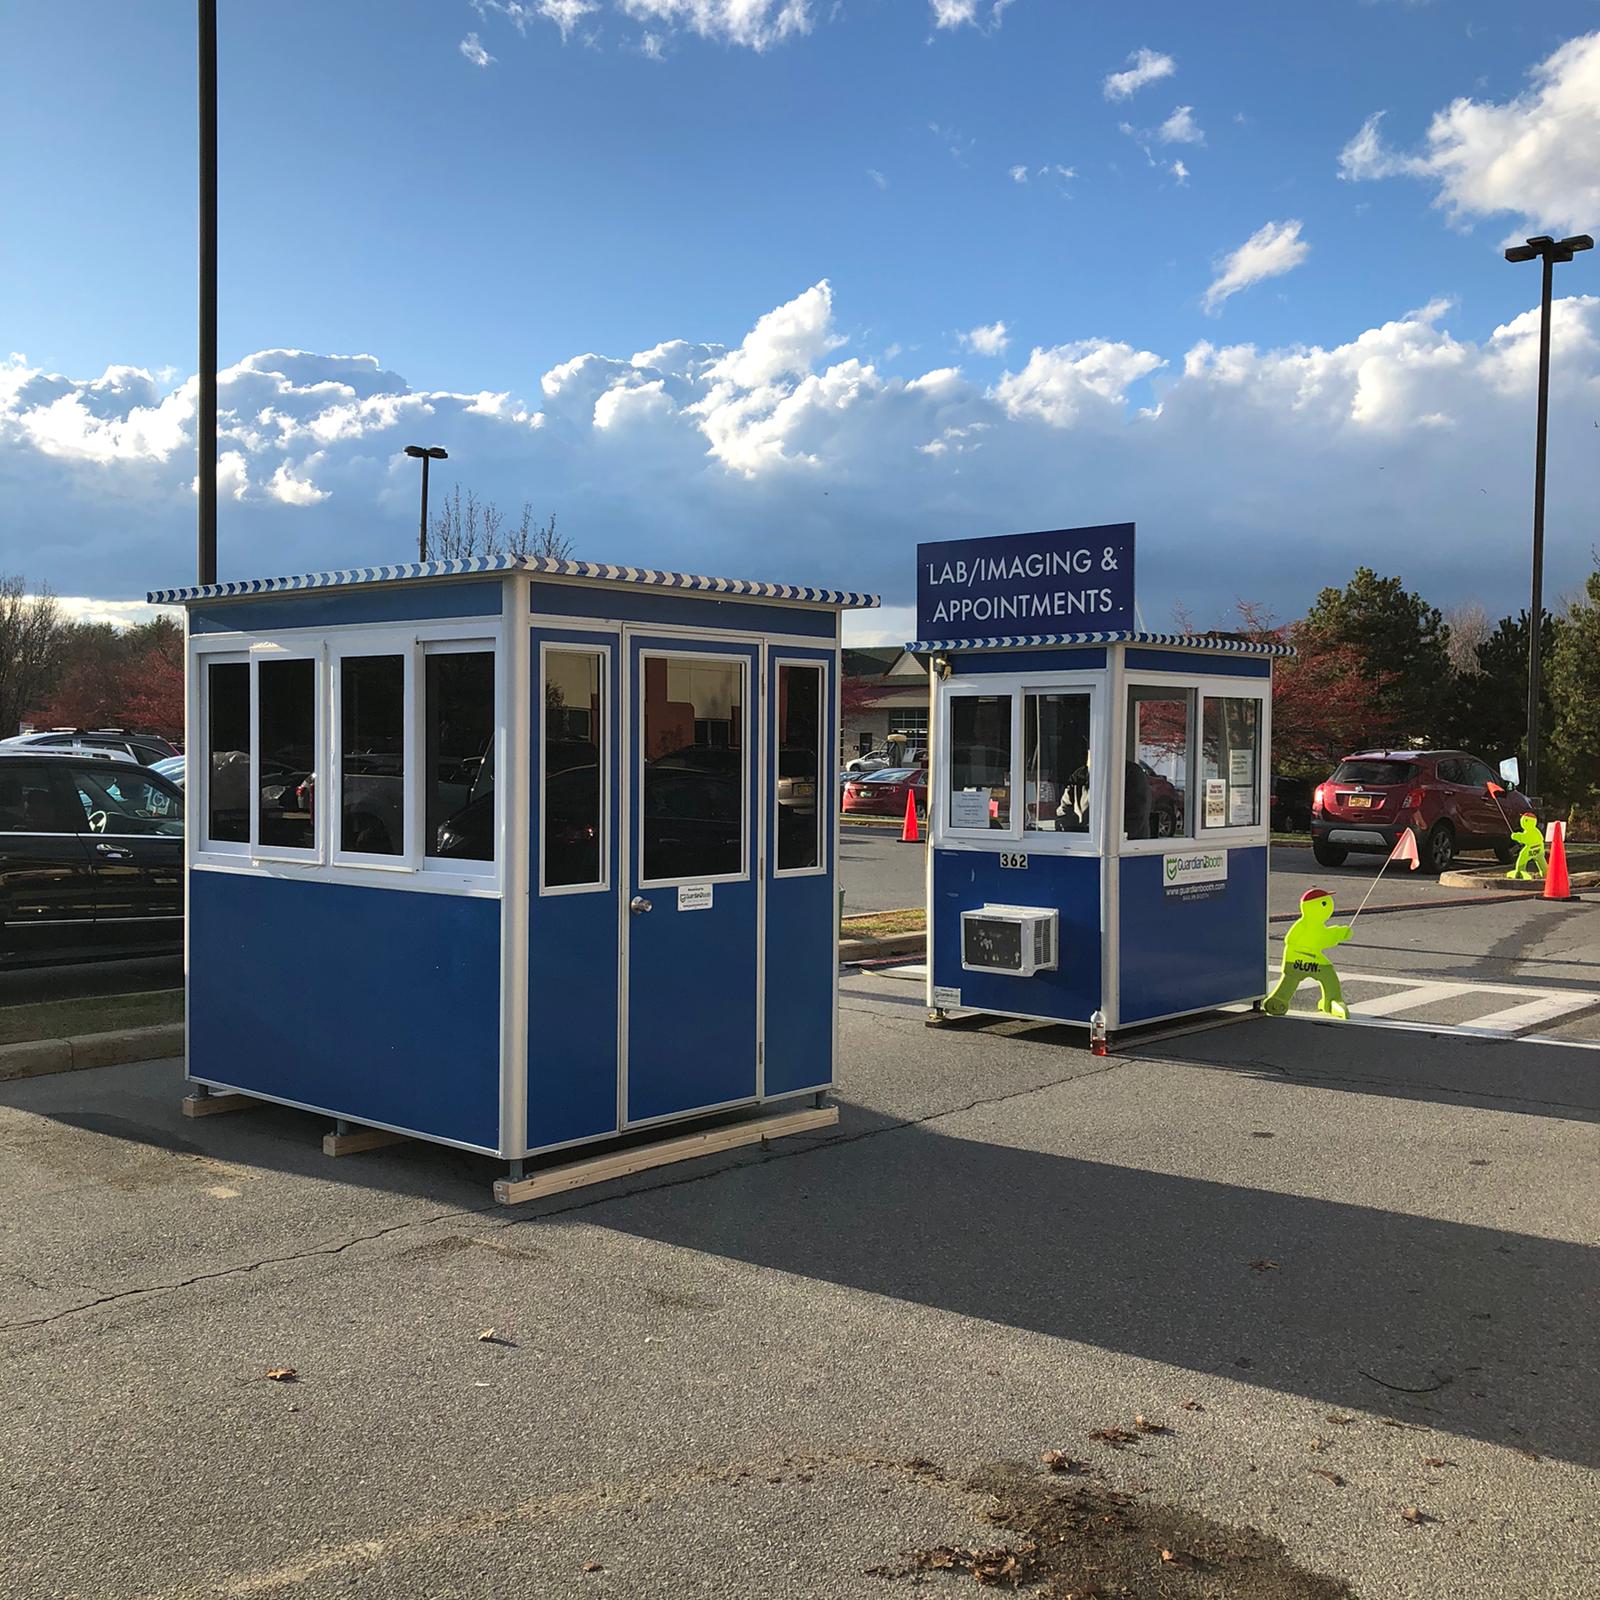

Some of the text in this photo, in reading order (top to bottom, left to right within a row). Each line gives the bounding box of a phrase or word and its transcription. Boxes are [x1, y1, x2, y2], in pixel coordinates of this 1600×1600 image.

[929, 546, 1119, 587] LAB/IMAGING &
[932, 588, 1113, 623] APPOINTMENTS
[1001, 853, 1027, 868] 362
